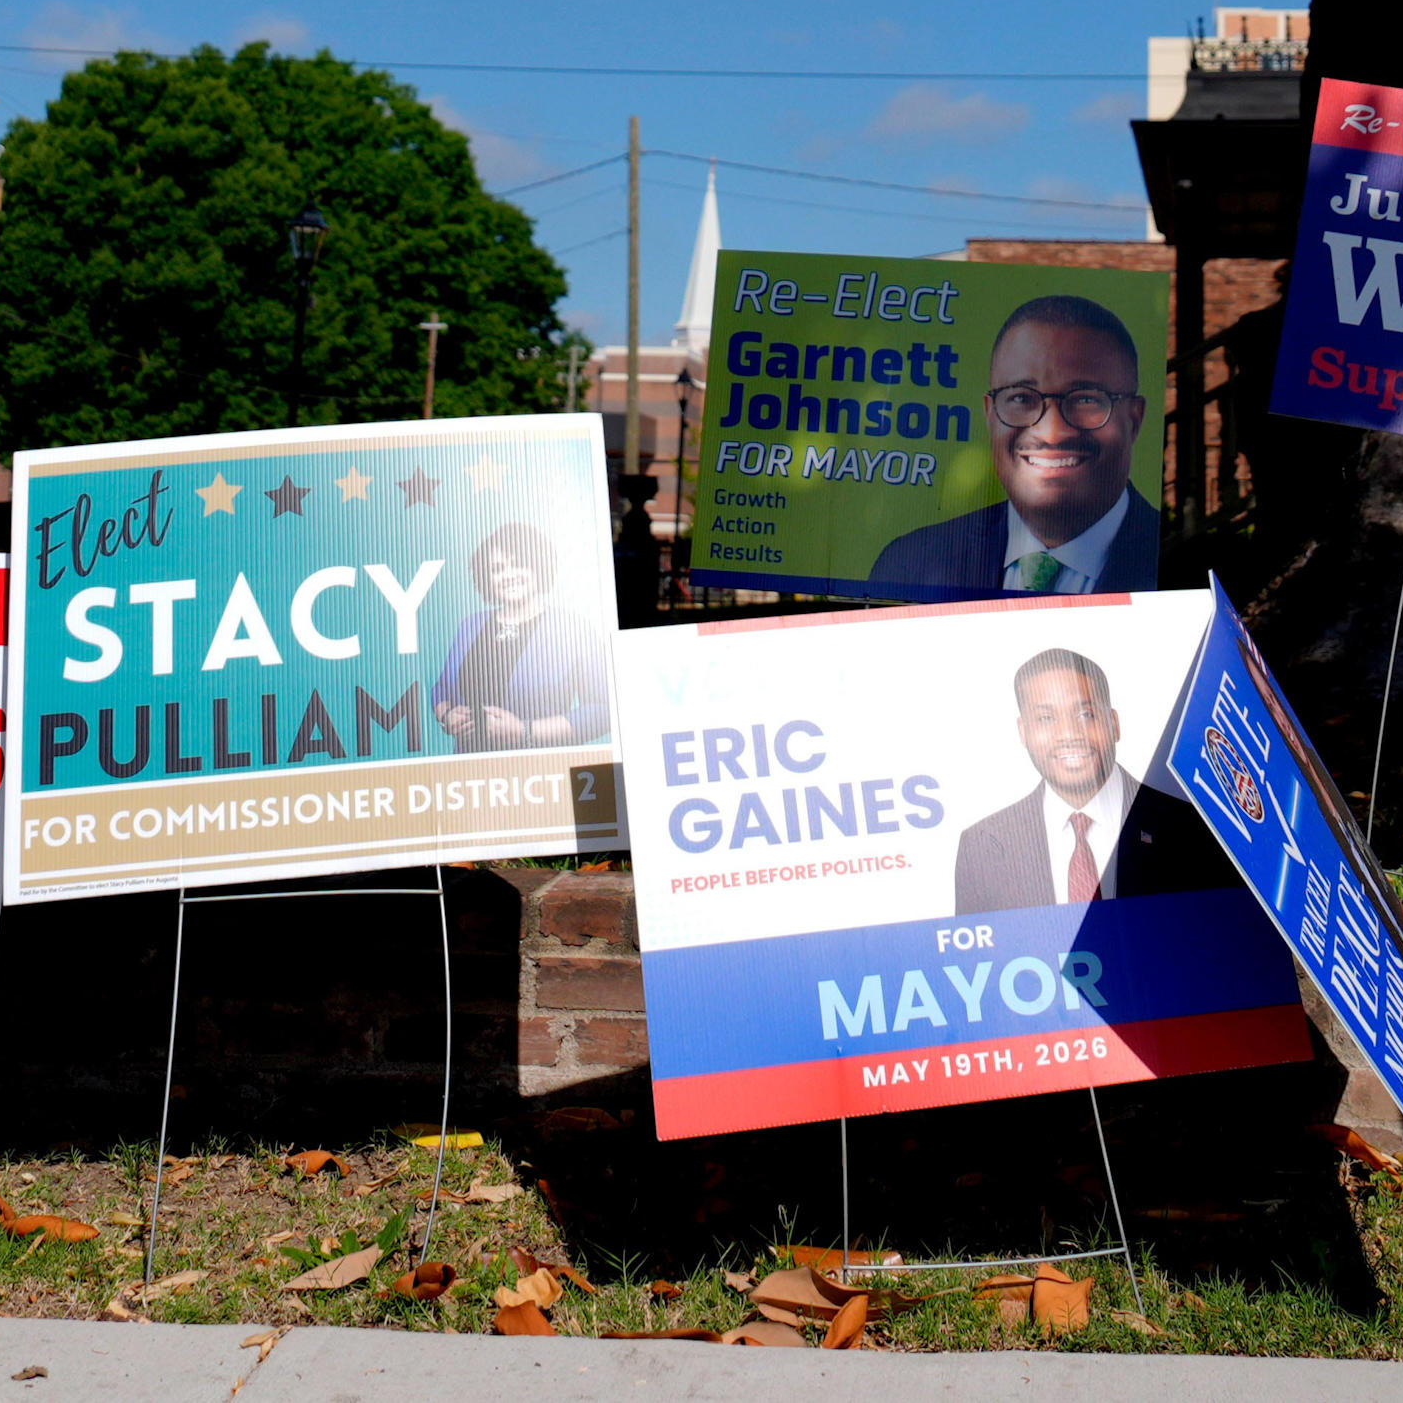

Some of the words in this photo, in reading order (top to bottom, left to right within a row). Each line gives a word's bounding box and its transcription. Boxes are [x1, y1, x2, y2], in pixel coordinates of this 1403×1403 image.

[734, 268, 960, 325] Re-Elect
[727, 330, 959, 388] Garnett
[720, 381, 971, 442] Johnson
[715, 440, 793, 477] FOR
[802, 445, 938, 487] MAYOR
[711, 516, 776, 535] Action
[713, 488, 786, 509] Growth
[35, 469, 174, 590] Elect
[710, 543, 783, 564] Results
[62, 559, 446, 683] STACY
[39, 680, 423, 786] PULLIAM
[660, 718, 828, 787] ERIC
[1194, 670, 1270, 844] VOTE
[23, 814, 96, 850] FOR
[108, 785, 402, 840] COMMISSIONER
[408, 773, 566, 812] DISTRICT
[576, 771, 597, 803] 2
[667, 773, 945, 855] GAINES
[670, 872, 741, 894] PEOPLE
[745, 863, 818, 886] BEFORE
[821, 853, 912, 877] POLITICS.
[936, 923, 995, 954] FOR
[817, 949, 1109, 1041] MAYOR
[862, 1059, 929, 1089] MAY
[942, 1049, 1025, 1079] 19TH,
[1034, 1036, 1109, 1067] 2026
